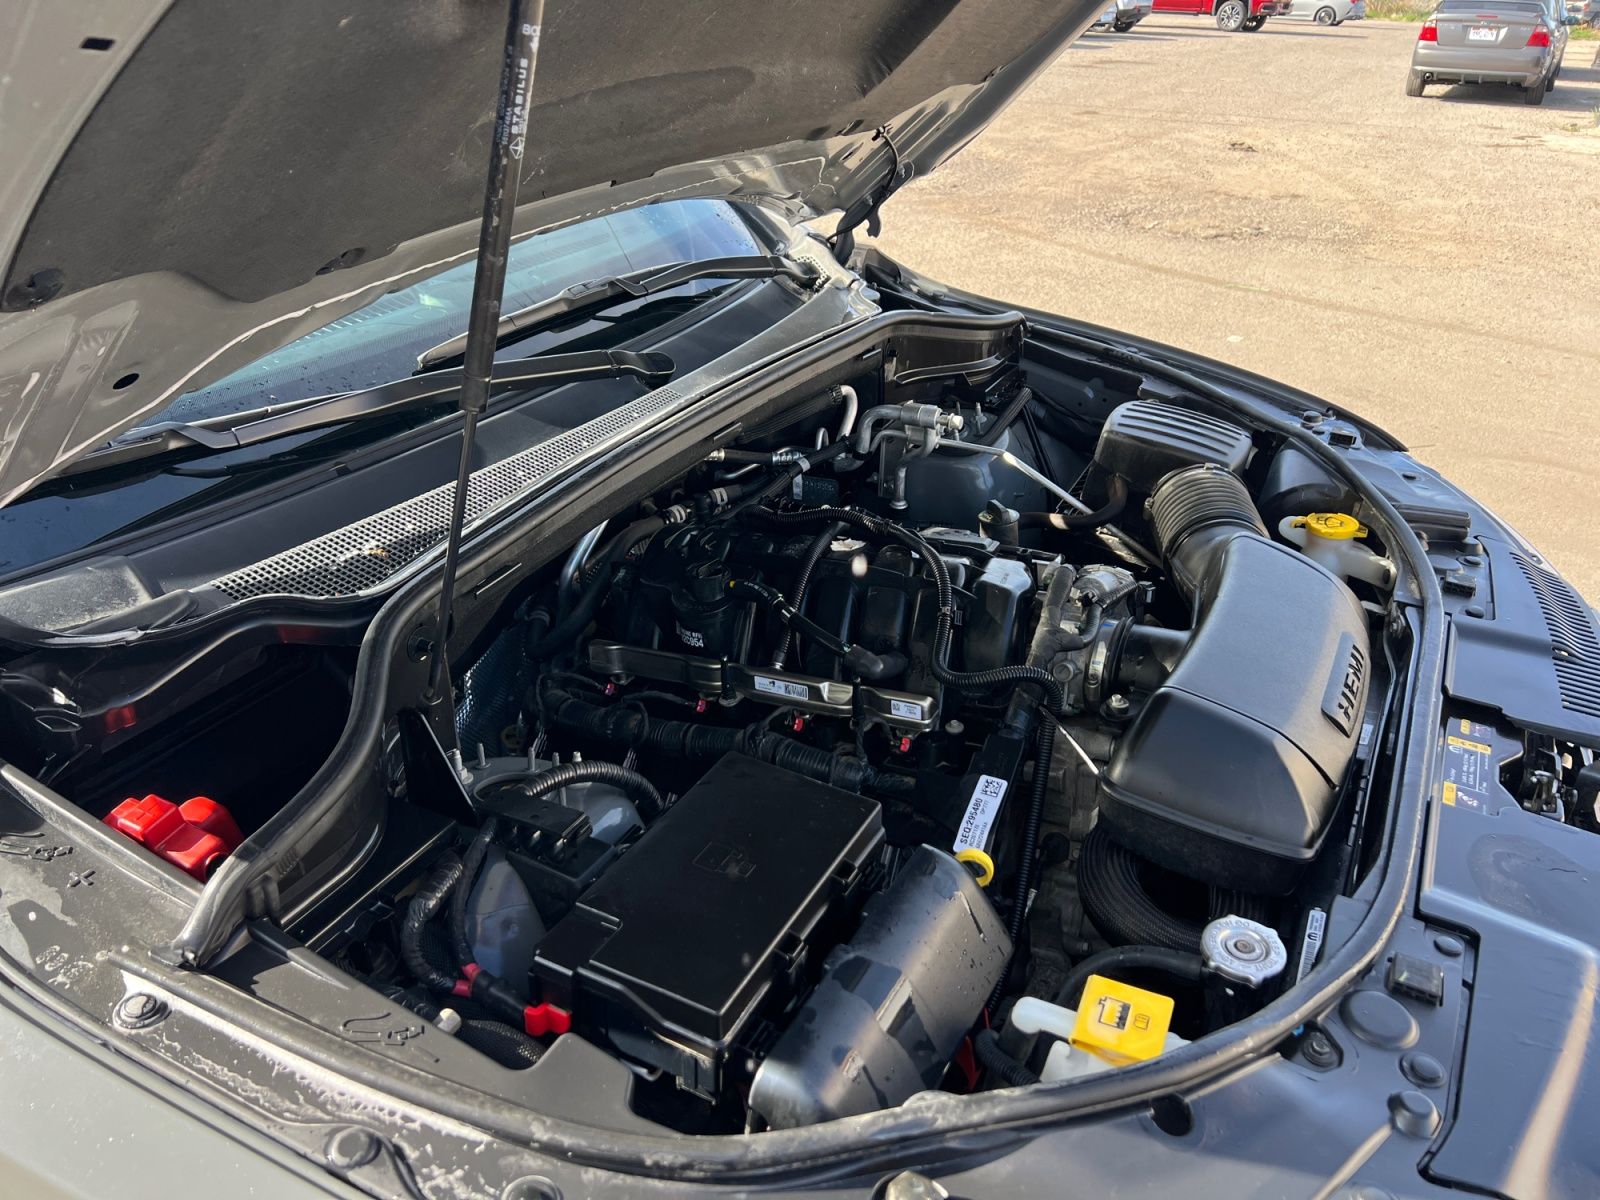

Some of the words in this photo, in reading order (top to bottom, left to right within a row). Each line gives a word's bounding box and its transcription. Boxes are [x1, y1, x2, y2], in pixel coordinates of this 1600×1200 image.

[511, 58, 529, 134] STABILUS
[1337, 643, 1365, 722] HEMI
[960, 797, 983, 845] SEQ:295480
